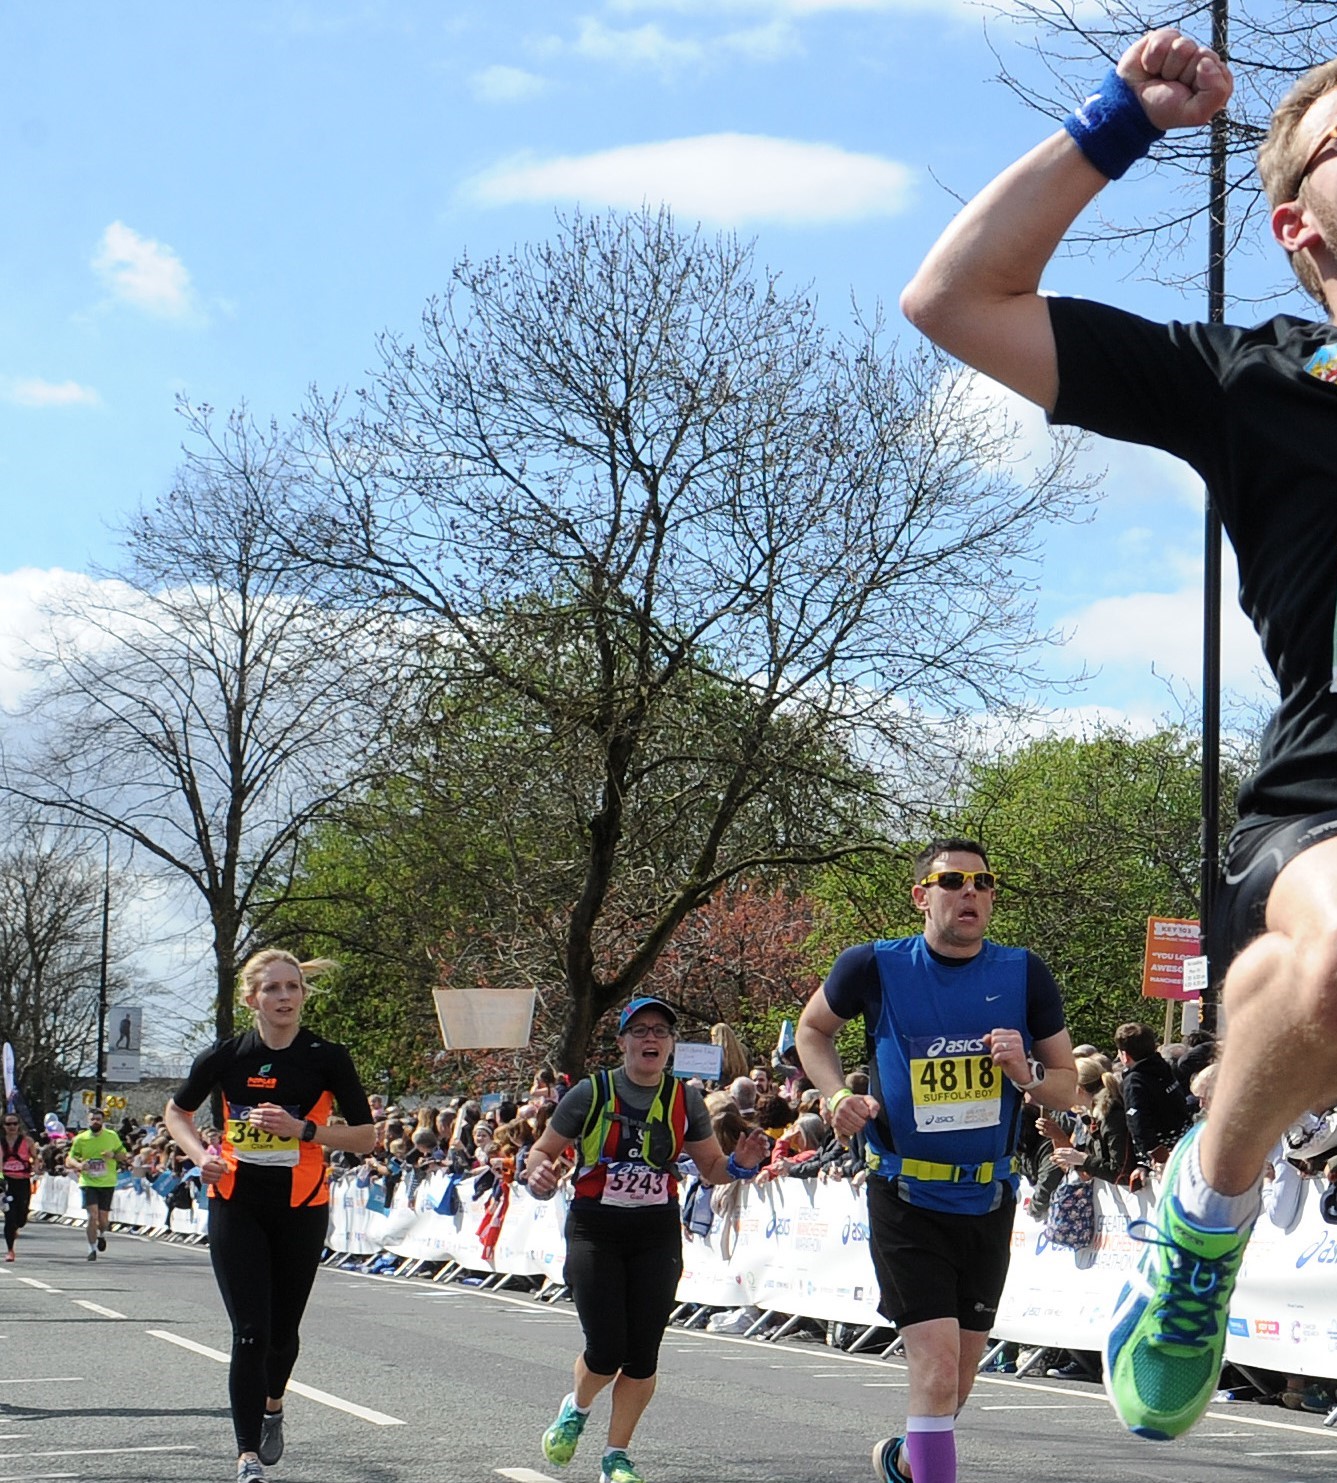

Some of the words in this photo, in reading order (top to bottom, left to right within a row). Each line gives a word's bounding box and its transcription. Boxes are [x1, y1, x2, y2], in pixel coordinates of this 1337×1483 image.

[945, 1039, 984, 1054] asics
[920, 1057, 995, 1092] 4818
[923, 1090, 972, 1103] SUFFOLK
[975, 1089, 994, 1099] BOY
[610, 1174, 663, 1195] 5243
